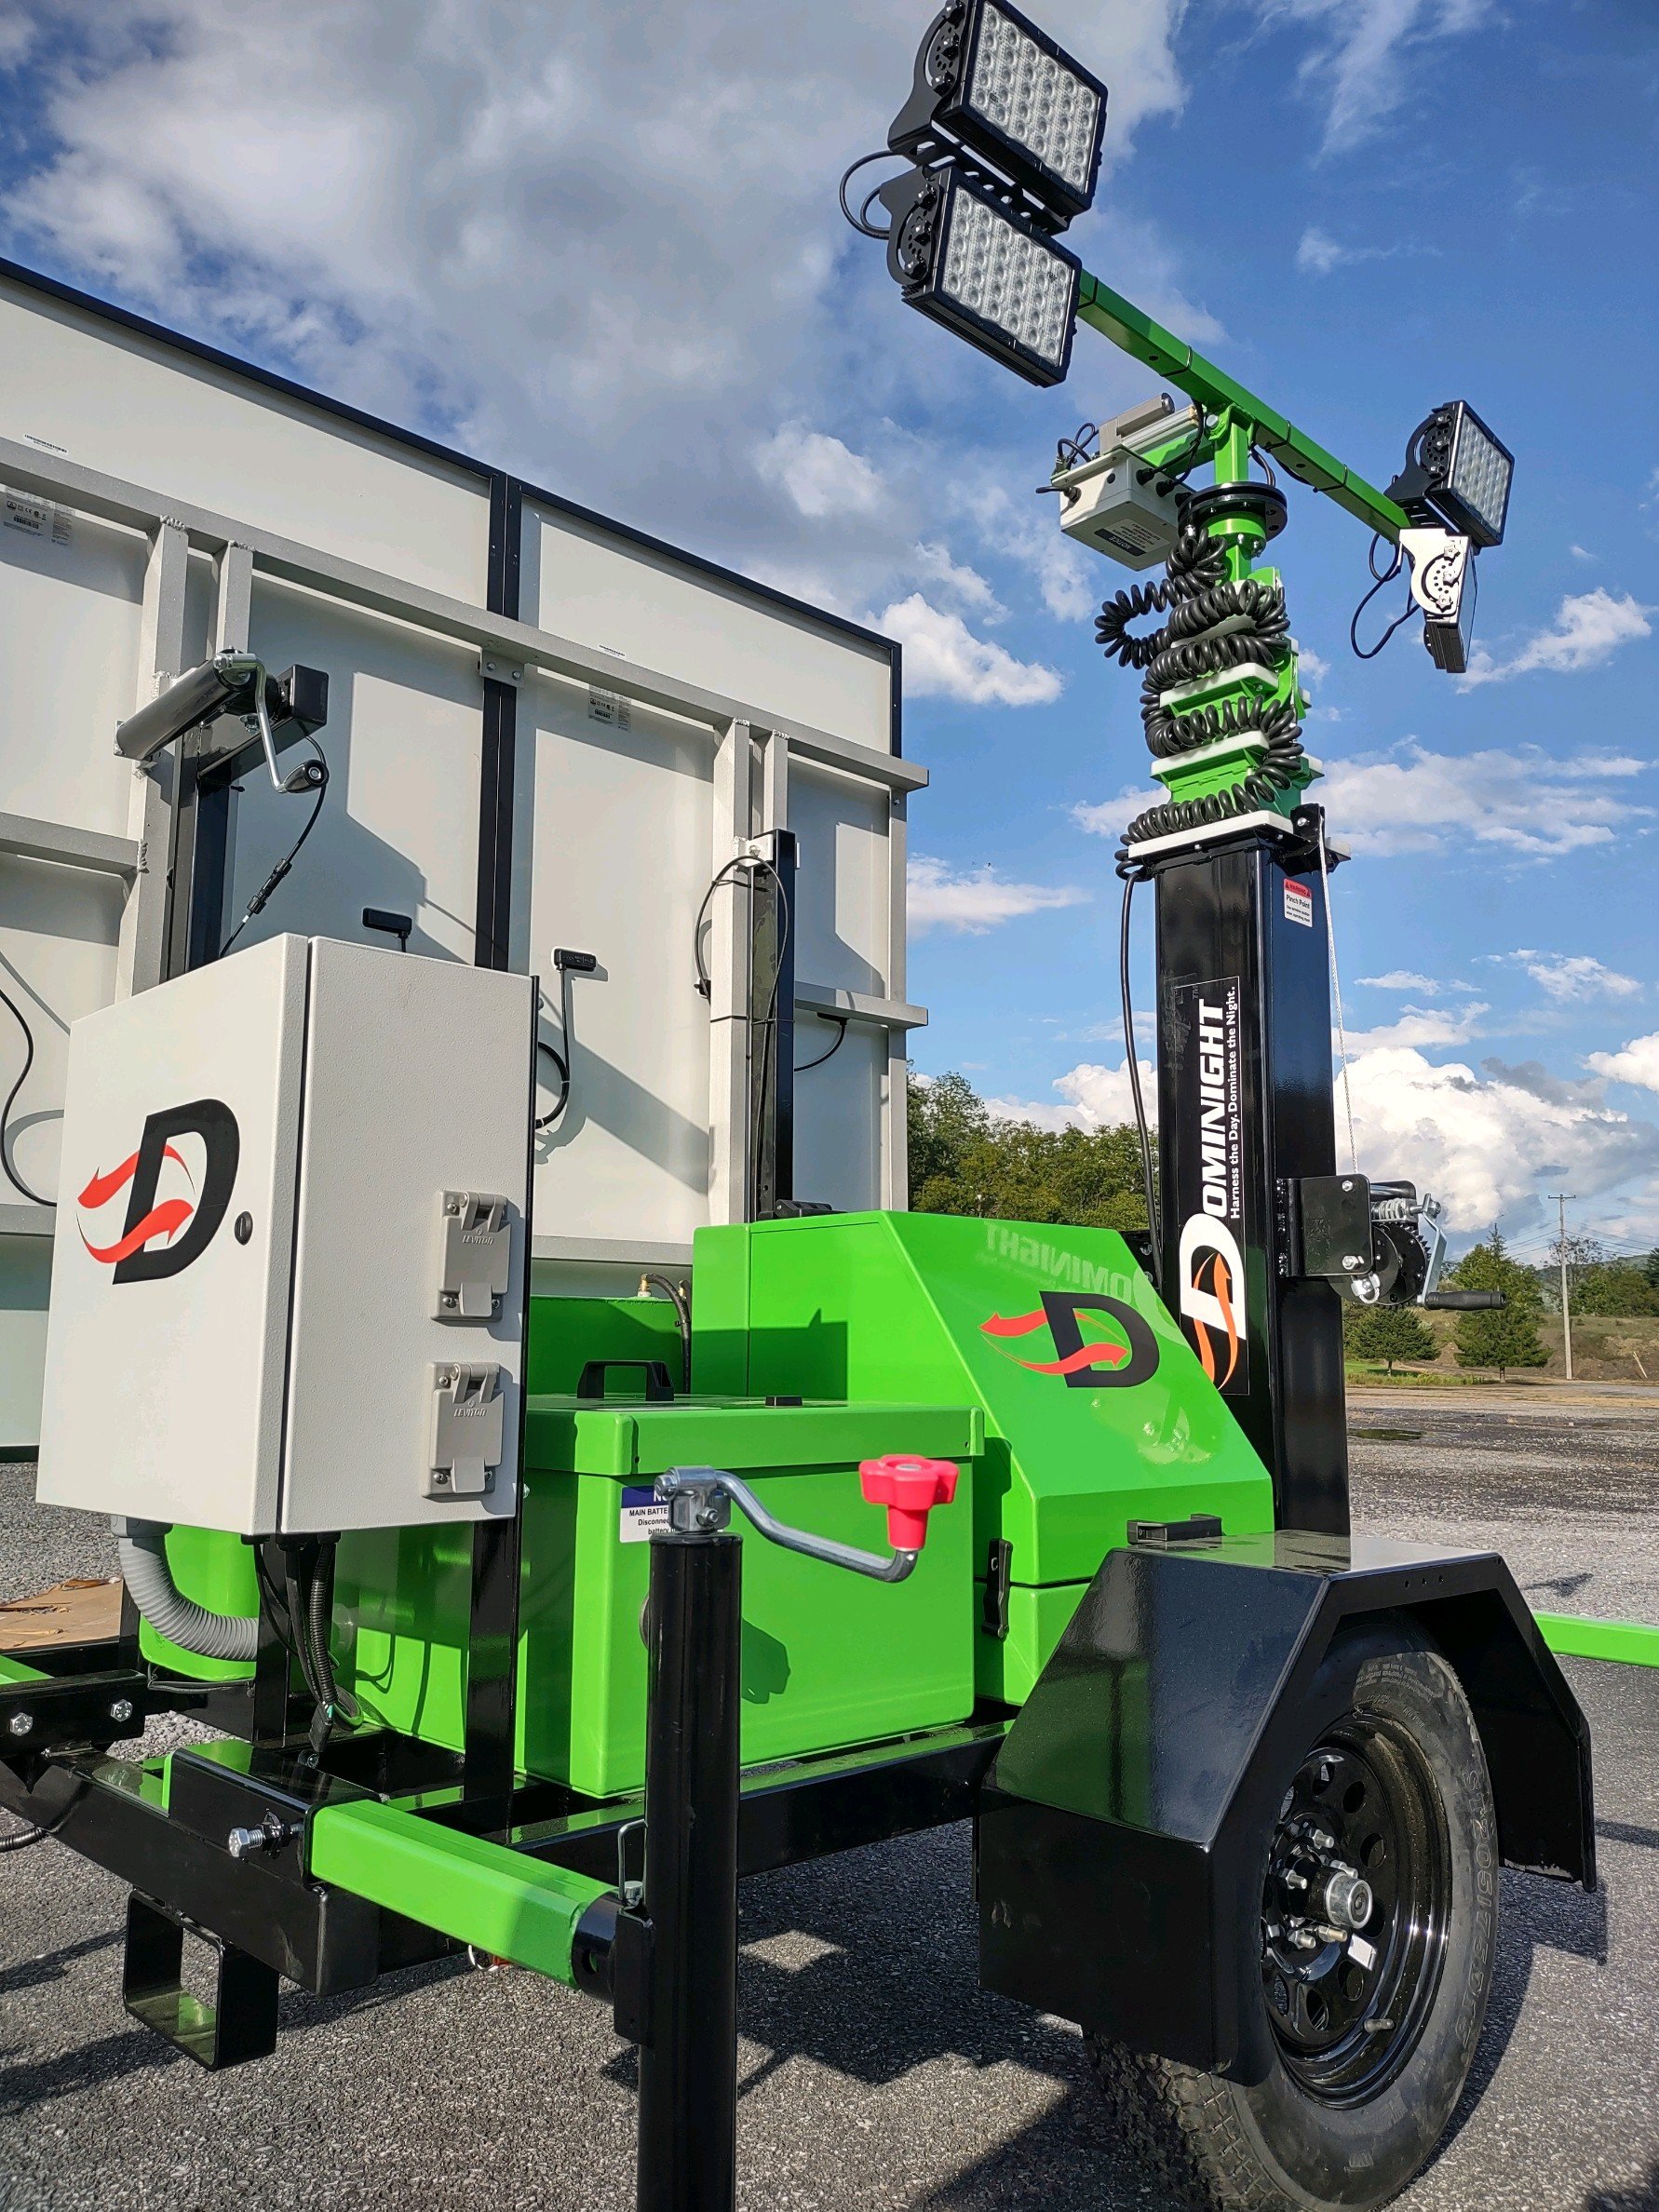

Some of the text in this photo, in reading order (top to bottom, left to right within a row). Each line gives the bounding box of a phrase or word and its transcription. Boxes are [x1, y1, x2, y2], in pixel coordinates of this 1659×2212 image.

[1286, 894, 1310, 909] Pinch Point
[1225, 986, 1240, 1220] Harness the Day. Dominate the Night.
[1180, 998, 1247, 1341] DOMINIGHT
[628, 1506, 668, 1517] MAIN BATTE
[638, 1517, 670, 1526] Disconnec
